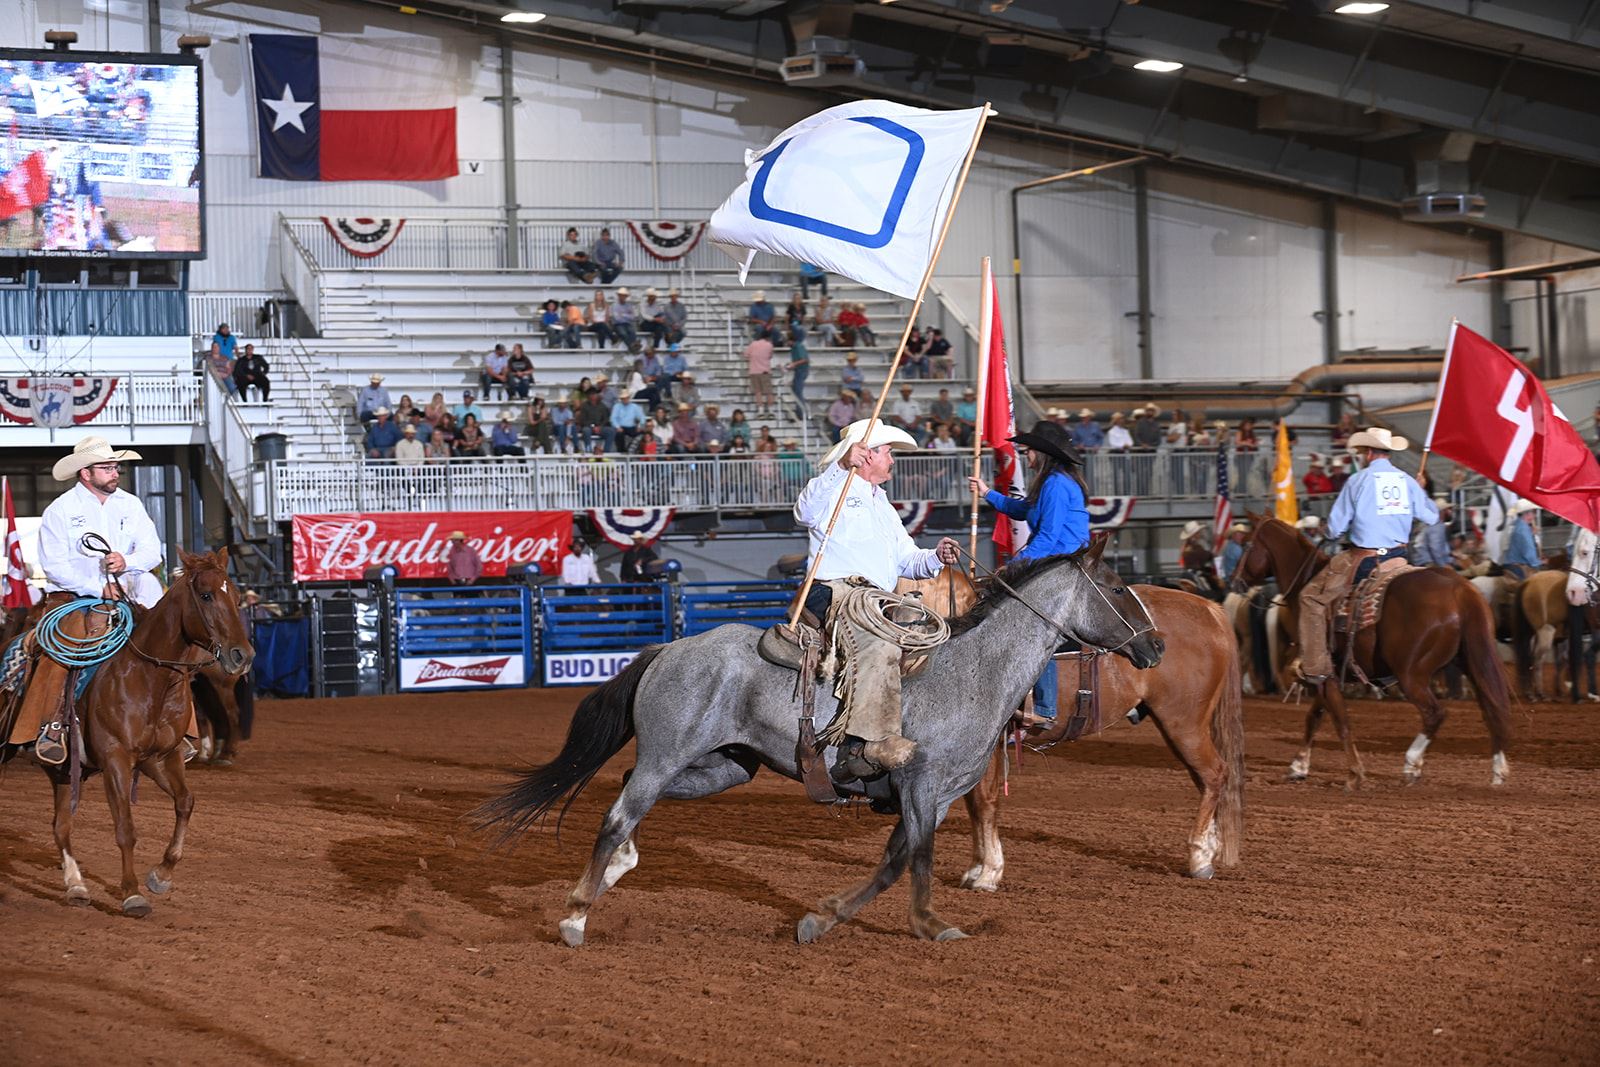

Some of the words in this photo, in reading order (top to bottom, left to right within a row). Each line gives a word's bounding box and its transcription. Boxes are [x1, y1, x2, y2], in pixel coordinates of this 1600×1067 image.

[469, 162, 480, 172] V
[29, 339, 40, 351] U
[1382, 485, 1401, 500] 60
[420, 663, 503, 680] Budweiser
[551, 659, 594, 678] BUD
